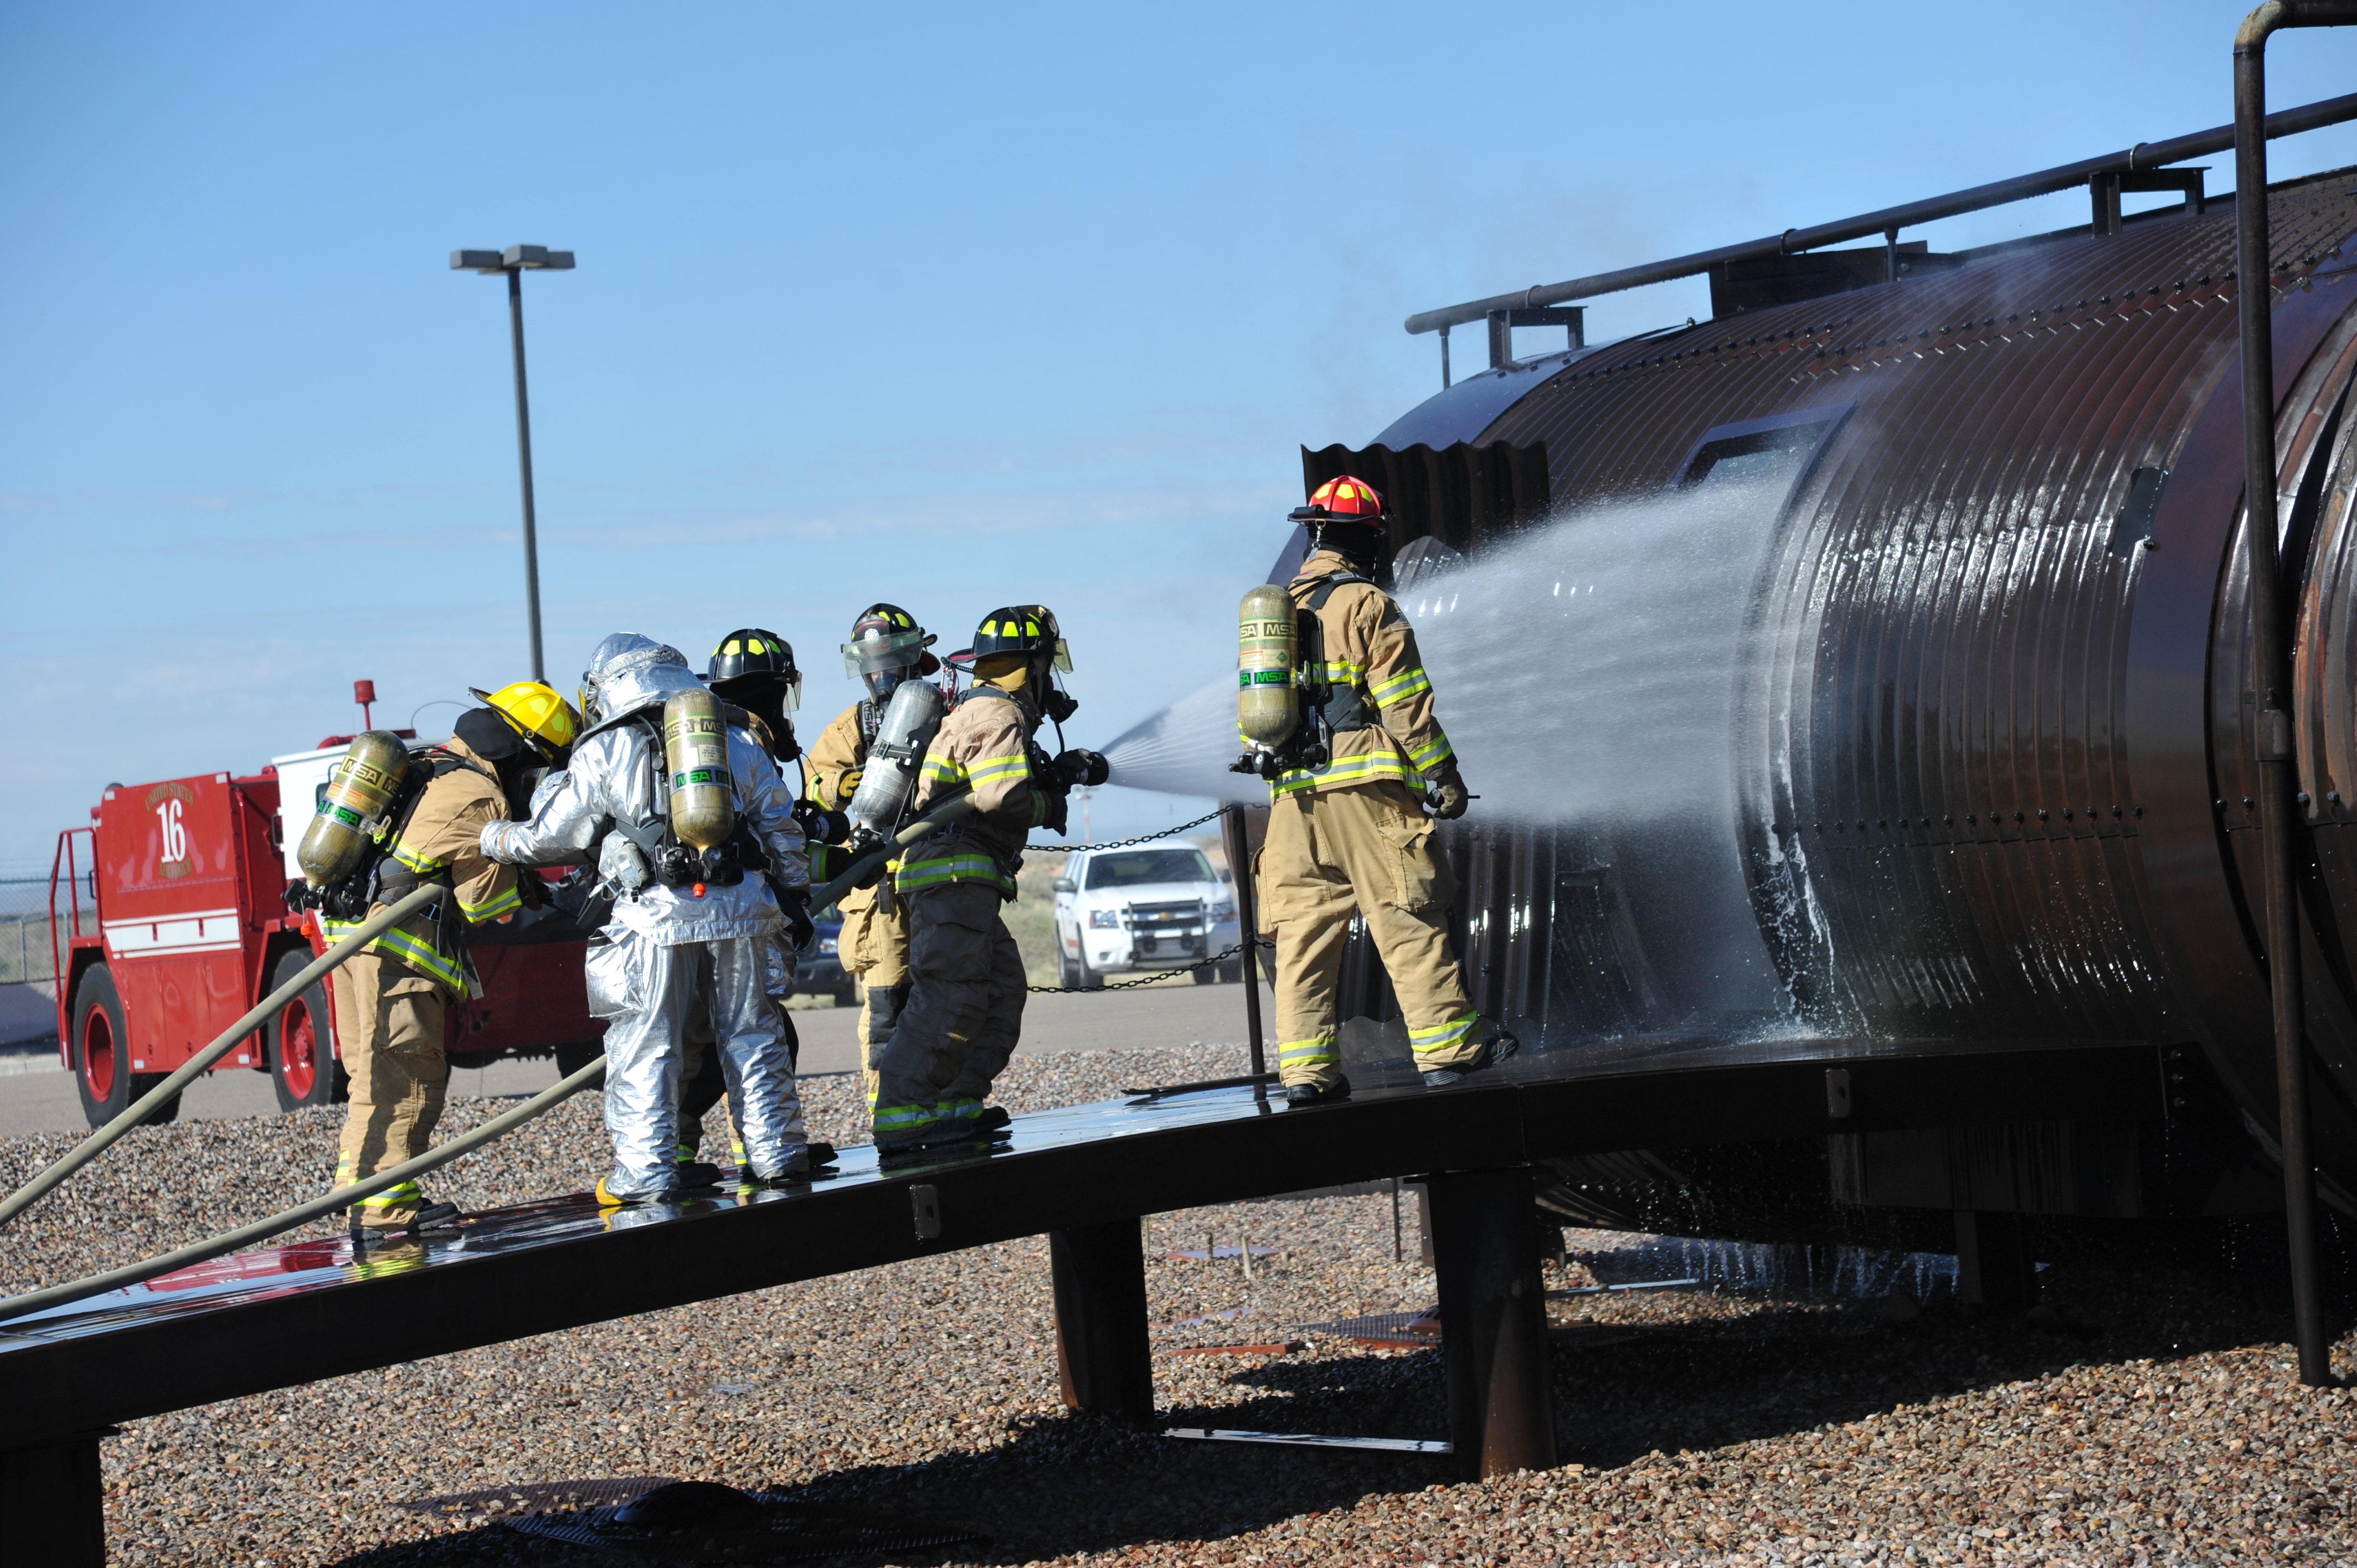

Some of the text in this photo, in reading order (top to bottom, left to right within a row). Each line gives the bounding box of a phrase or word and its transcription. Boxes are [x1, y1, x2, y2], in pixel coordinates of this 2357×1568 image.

[1239, 623, 1296, 637] SA MSA
[1256, 672, 1288, 683] MSA
[864, 705, 874, 734] MSA
[344, 760, 378, 784] MSA
[677, 771, 711, 787] MSA
[145, 782, 194, 812] UNITED STATES
[156, 798, 187, 864] 16
[159, 857, 193, 879] AIR FORCE
